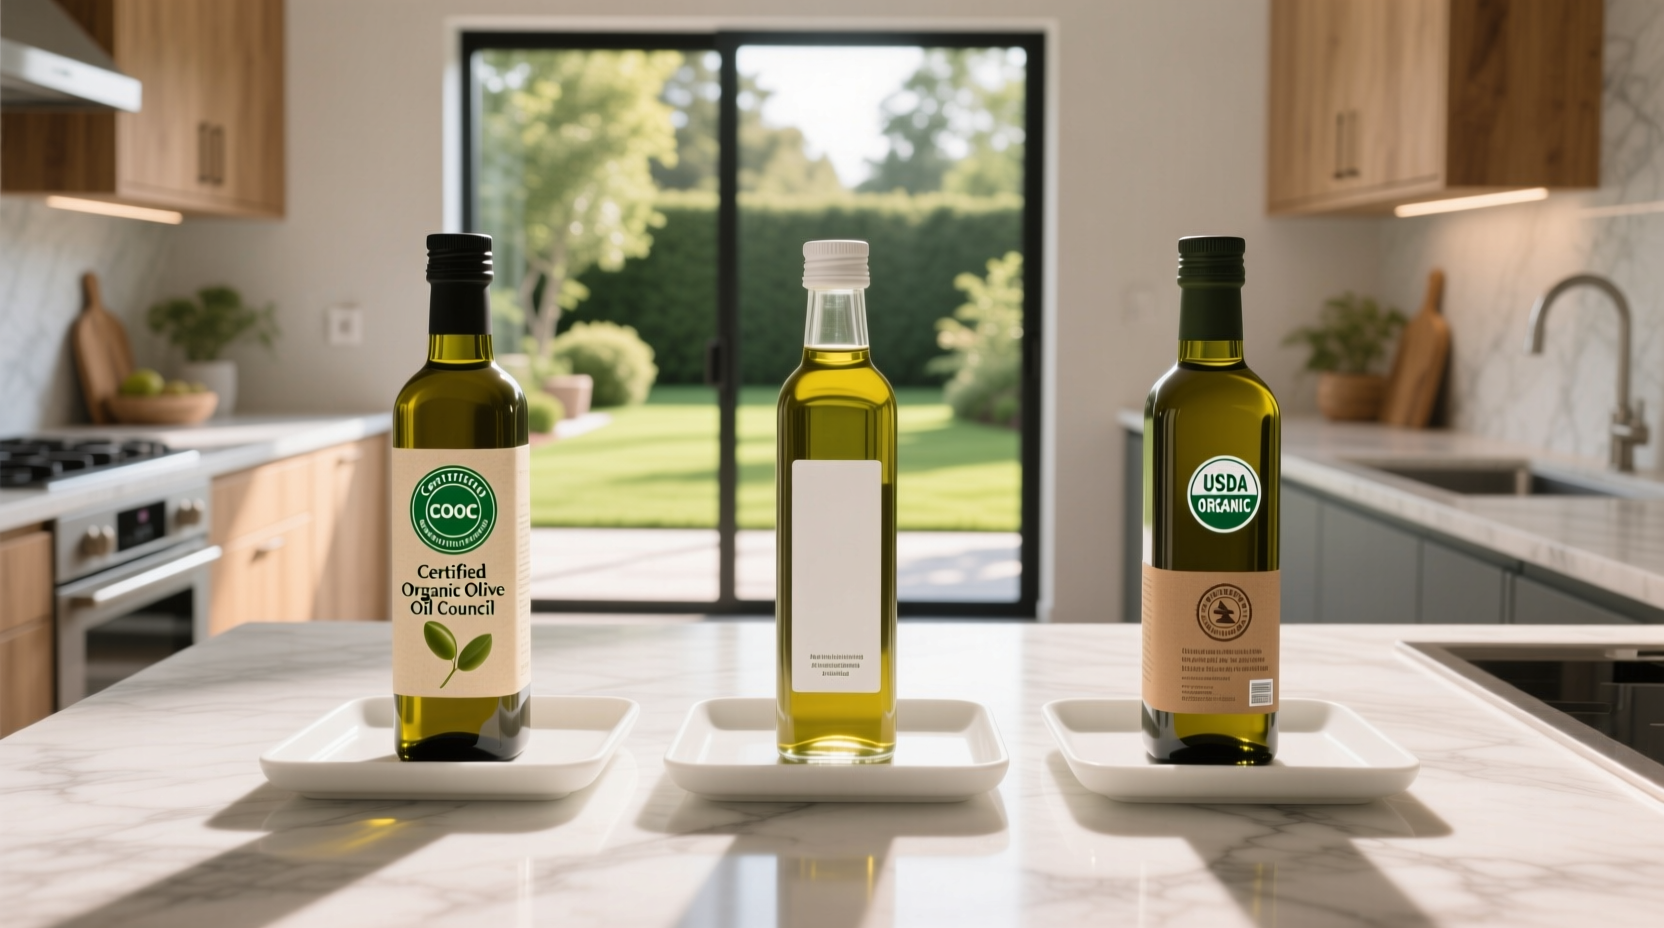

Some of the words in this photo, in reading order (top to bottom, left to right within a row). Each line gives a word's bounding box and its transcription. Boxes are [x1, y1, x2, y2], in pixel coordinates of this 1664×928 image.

[1203, 473, 1248, 492] USDA
[429, 503, 478, 519] COOC
[417, 563, 487, 579] Certified
[401, 582, 461, 601] Organic
[464, 582, 506, 598] Olive
[410, 599, 433, 615] Oil
[437, 600, 495, 615] Council
